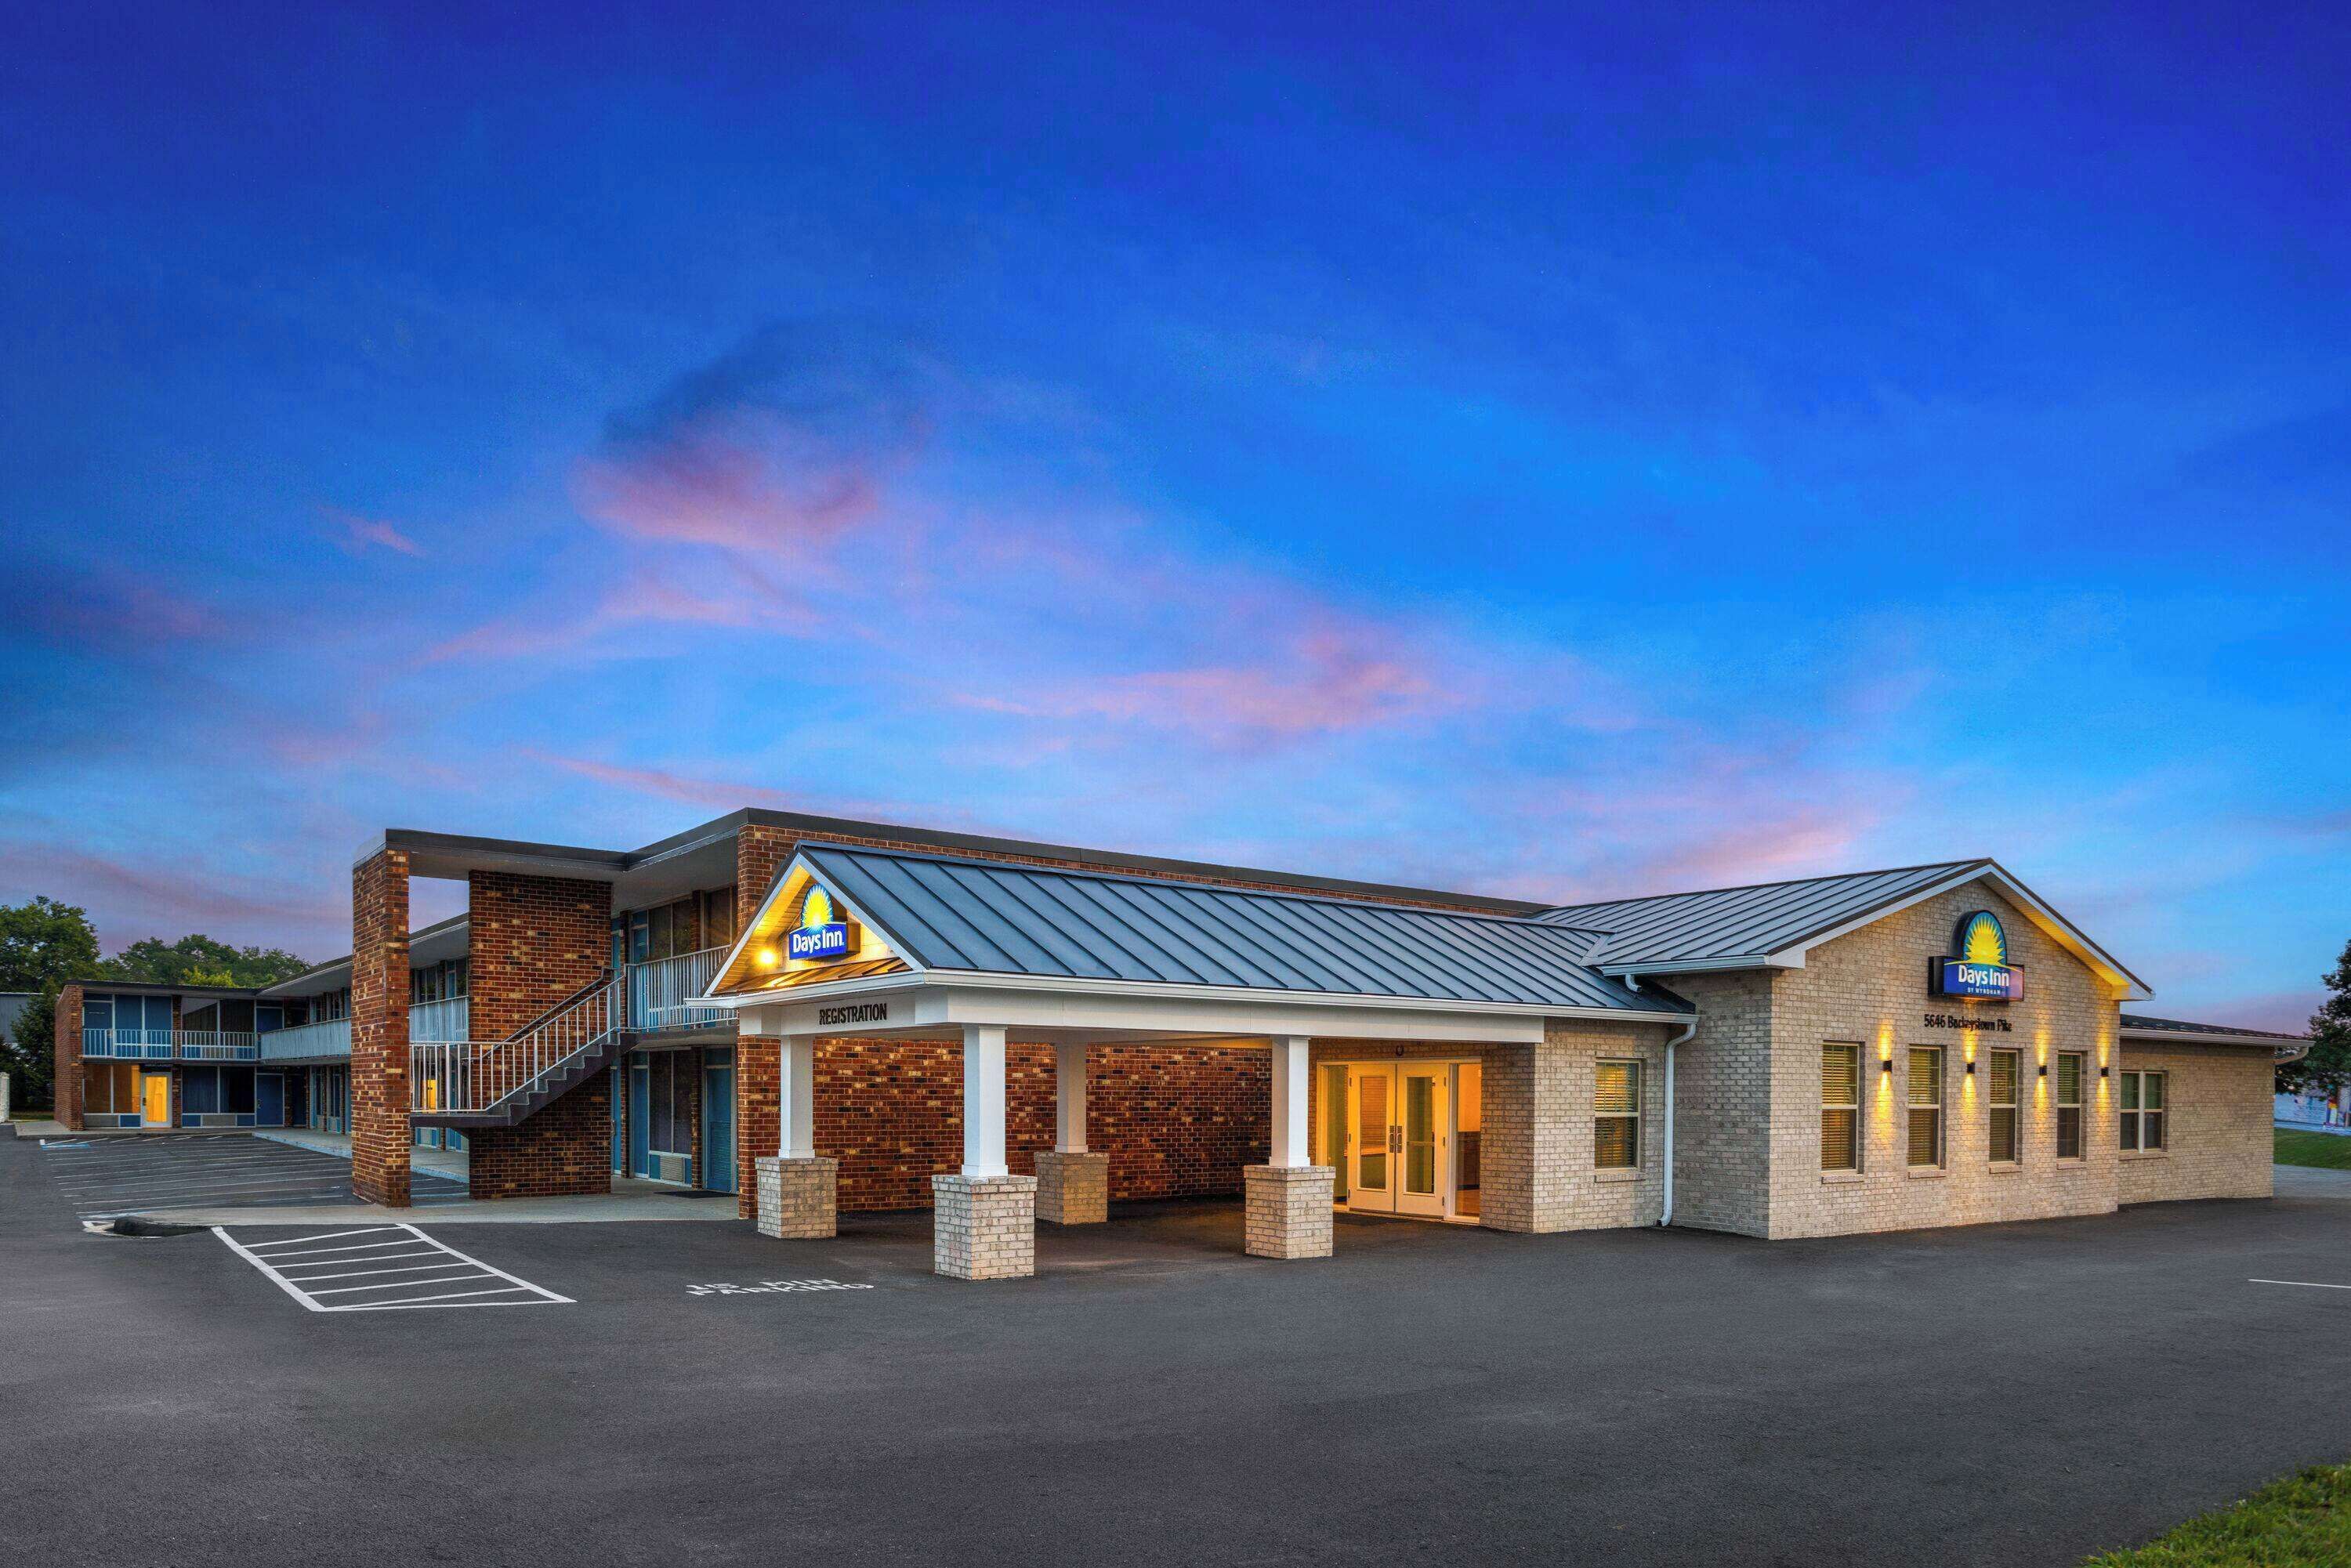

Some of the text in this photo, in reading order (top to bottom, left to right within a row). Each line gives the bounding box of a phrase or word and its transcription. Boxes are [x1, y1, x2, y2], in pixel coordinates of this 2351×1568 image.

[793, 930, 842, 953] Days Inn
[1958, 964, 2009, 987] Days Inn
[819, 1003, 887, 1025] REGISTRATION
[1924, 1013, 1946, 1027] 5646
[686, 1284, 875, 1295] PARKING
